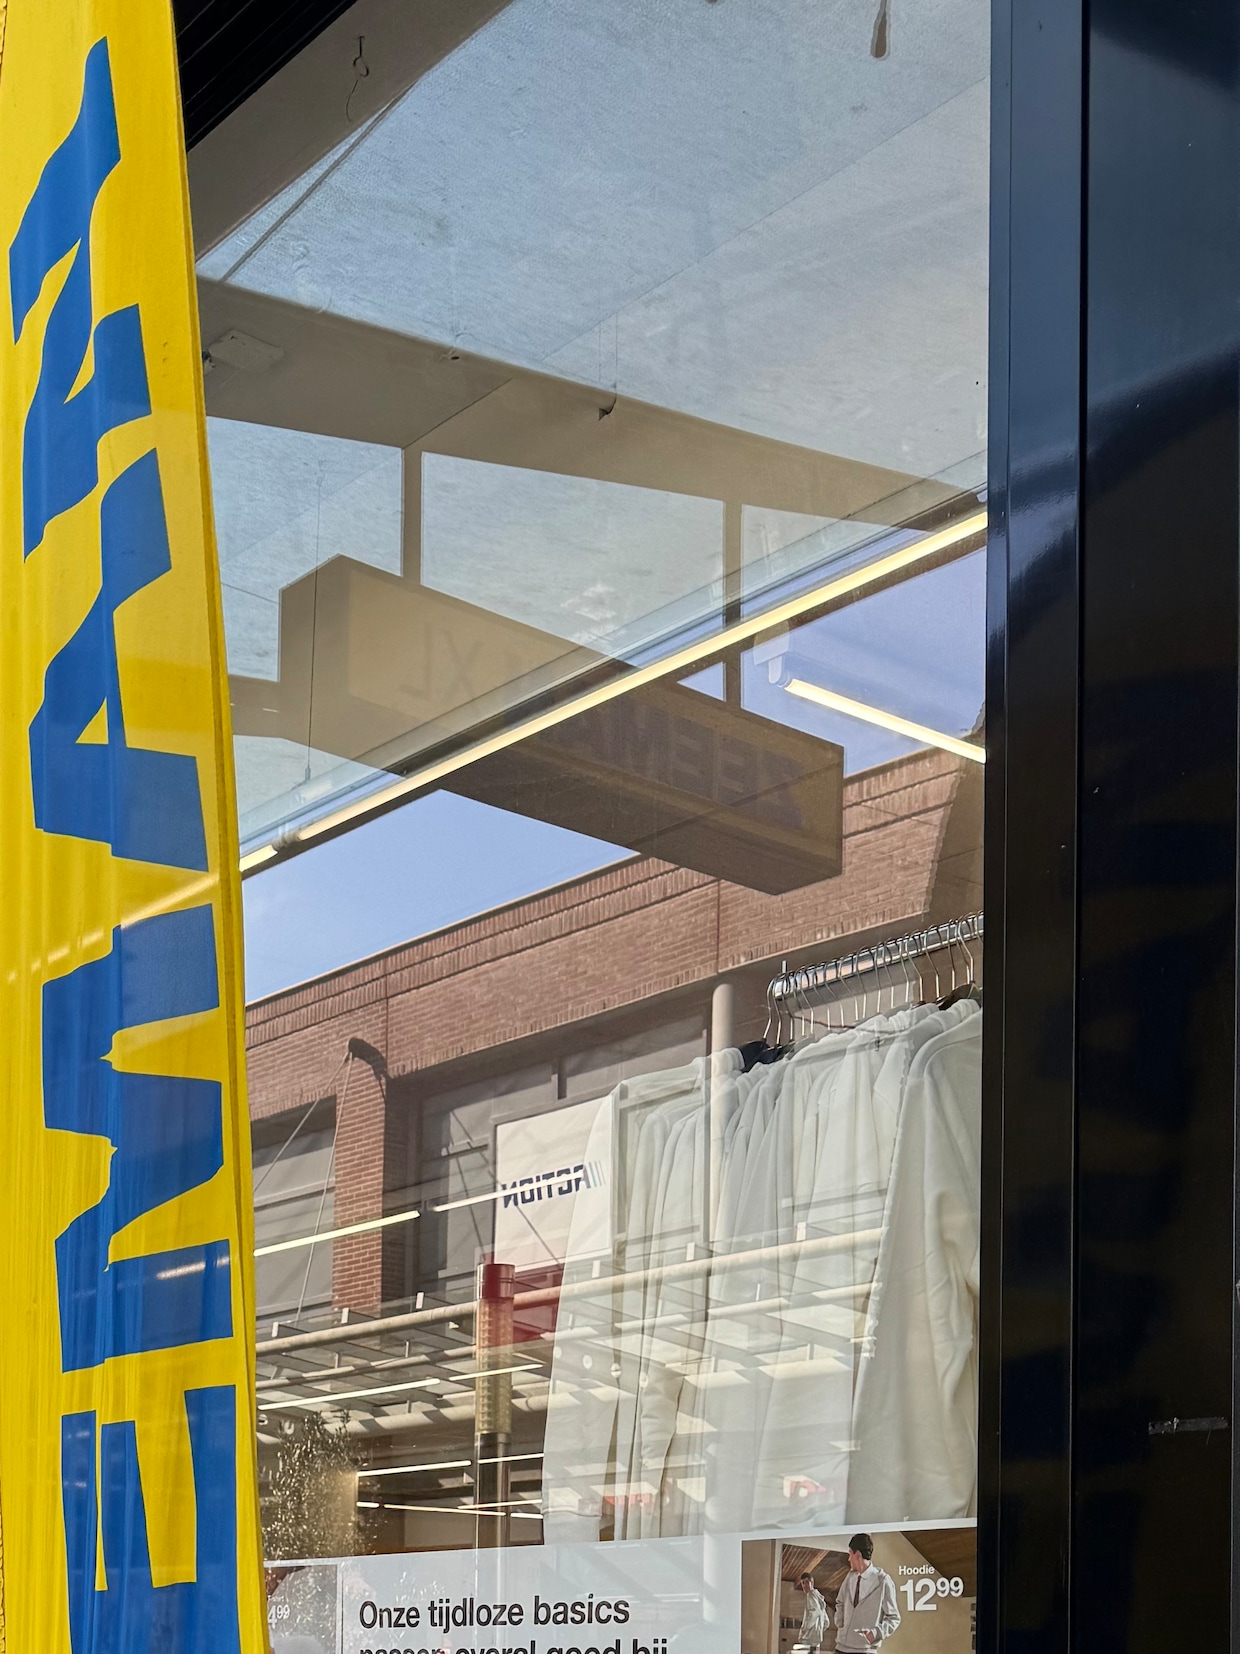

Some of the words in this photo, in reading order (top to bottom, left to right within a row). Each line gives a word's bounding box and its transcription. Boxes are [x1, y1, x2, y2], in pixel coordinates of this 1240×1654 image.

[898, 1564, 935, 1576] Hoodie
[900, 1577, 964, 1611] 1299
[359, 1600, 421, 1630] Onze
[427, 1597, 524, 1634] tijdloze
[533, 1593, 630, 1626] basics
